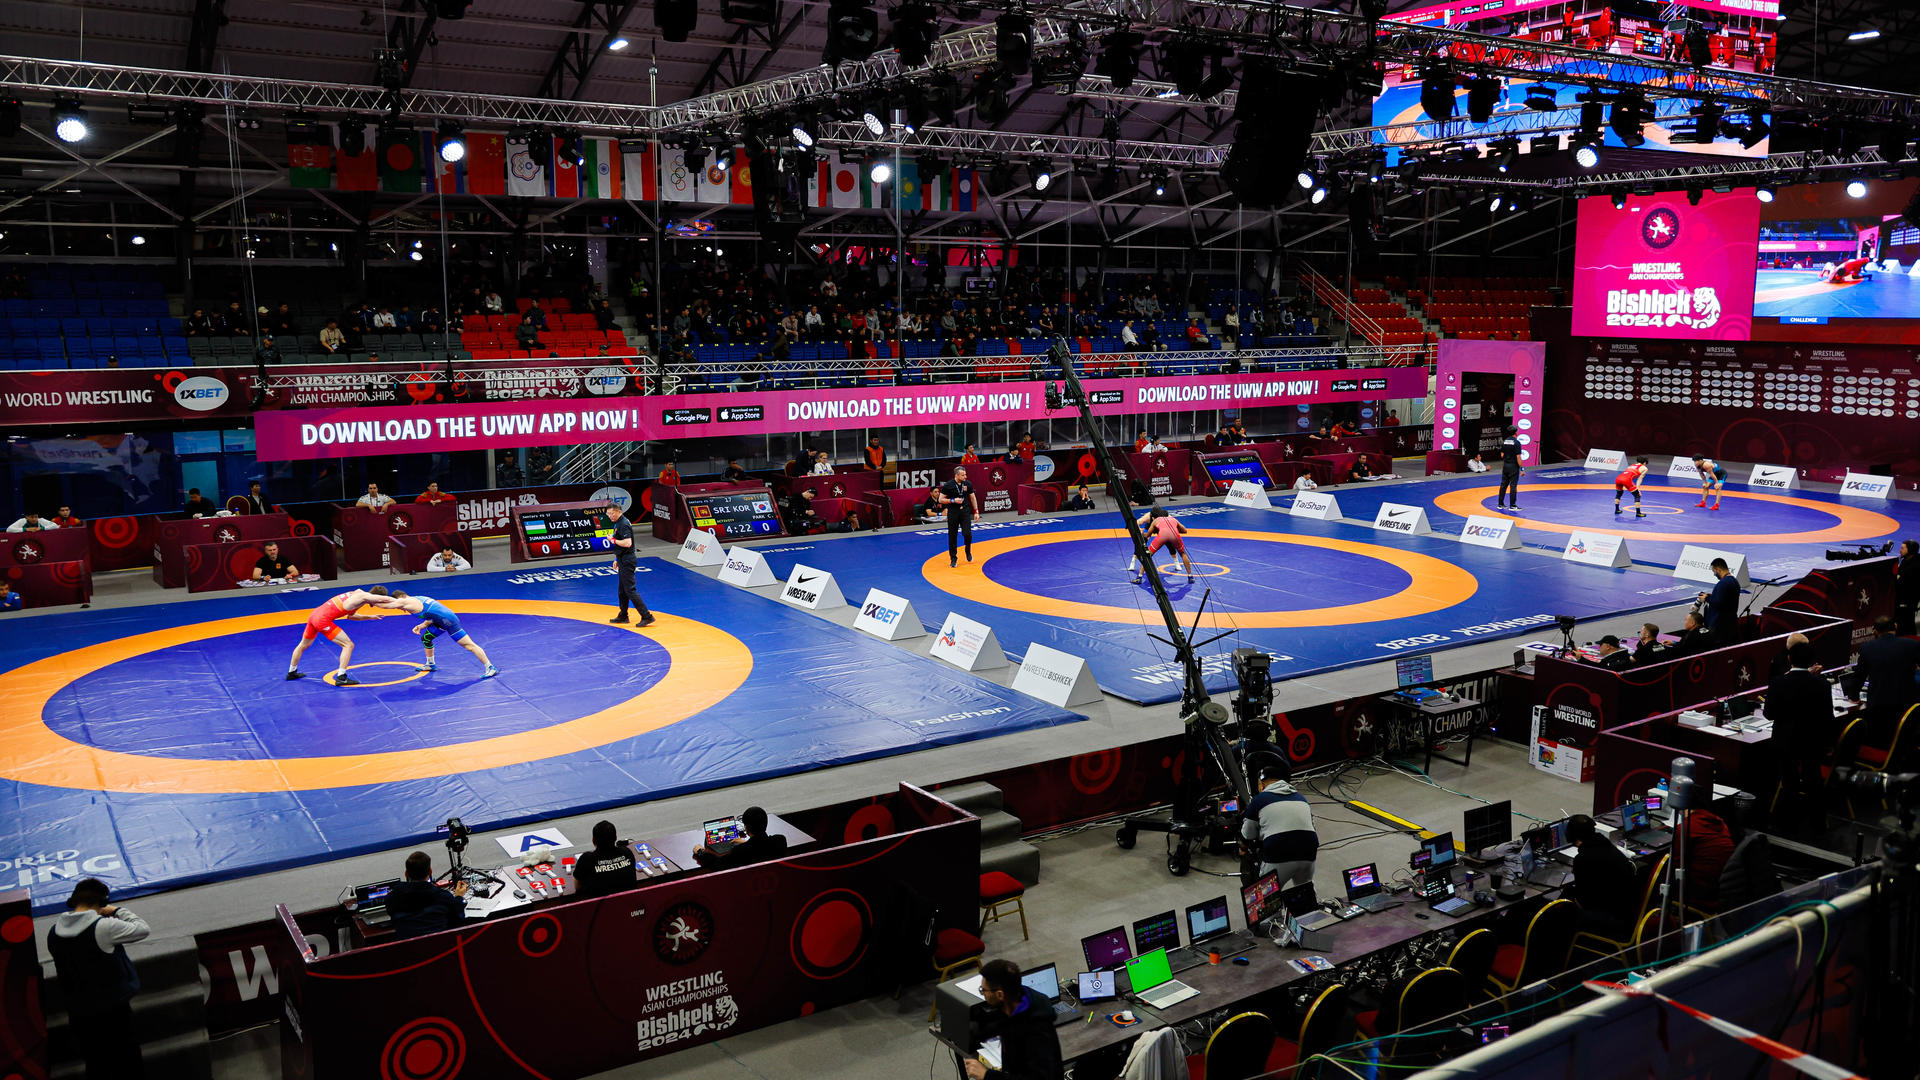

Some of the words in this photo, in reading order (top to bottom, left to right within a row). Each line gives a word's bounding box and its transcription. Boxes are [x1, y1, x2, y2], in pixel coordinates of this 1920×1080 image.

[1632, 262, 1681, 273] WRESTLING
[1606, 289, 1691, 314] Bishkek
[1606, 314, 1664, 327] 2024
[4, 392, 62, 407] WORLD
[65, 389, 152, 406] WRESTLING
[179, 388, 223, 399] 1XBET
[290, 393, 318, 404] ASIAN
[321, 390, 395, 403] CHAMPIONSHIPS
[486, 389, 536, 399] 2024
[1138, 386, 1207, 403] DOWNLOAD
[1210, 385, 1231, 399] THE
[1234, 382, 1262, 398] UWW
[1264, 381, 1284, 397] APP
[1287, 380, 1313, 396] NOW
[788, 399, 880, 420] DOWNLOAD
[884, 398, 912, 415] THE
[916, 396, 955, 414] UWW
[957, 394, 985, 412] APP
[988, 393, 1023, 411] NOW
[675, 414, 695, 423] Google
[696, 413, 709, 421] Play
[302, 418, 432, 445] DOWNLOAD
[436, 417, 476, 438] THE
[482, 414, 534, 437] UWW
[539, 412, 576, 433] APP
[582, 410, 627, 431] NOW
[1588, 456, 1619, 465] UWW.ORG
[1221, 468, 1252, 476] CHALLENGE
[1754, 479, 1785, 488] WRESTLING
[1846, 481, 1886, 493] 1XBET
[1230, 489, 1256, 501] UWW.ORG
[713, 506, 731, 514] SRI
[733, 504, 751, 512] KOR
[1296, 500, 1327, 512] TaiShan
[549, 520, 569, 530] UZB
[571, 519, 591, 528] TKM
[726, 524, 752, 533] 4:22
[762, 523, 770, 532] 0
[1379, 519, 1411, 531] WRESTLING
[1466, 525, 1507, 540] 1XBET
[541, 544, 550, 554] 0
[562, 540, 591, 551] 4:33
[602, 539, 611, 549] 0
[685, 540, 707, 554] UWW.ORG
[726, 558, 752, 574] TaiShan
[787, 586, 817, 603] WRESTLING
[863, 602, 900, 625] 1XBET
[1452, 614, 1555, 636] BISHKEK
[1376, 633, 1451, 650] 2024
[1528, 643, 1560, 652] B
[1022, 663, 1073, 687] #WRESTLEBISHKEK
[910, 705, 1012, 727] TaiShan
[1558, 703, 1575, 713] UNITED
[1575, 707, 1592, 718] WORLD
[1554, 709, 1597, 729] WRESTLING
[519, 834, 561, 852] A
[595, 859, 631, 873] WRESTLING
[612, 856, 626, 864] WORLD
[645, 970, 724, 1001] WRESTLING
[641, 1000, 665, 1014] ASIAN
[666, 983, 729, 1008] CHAMPIONSHIPS
[637, 1002, 714, 1041] Bishkek
[638, 1028, 692, 1051] 2024
